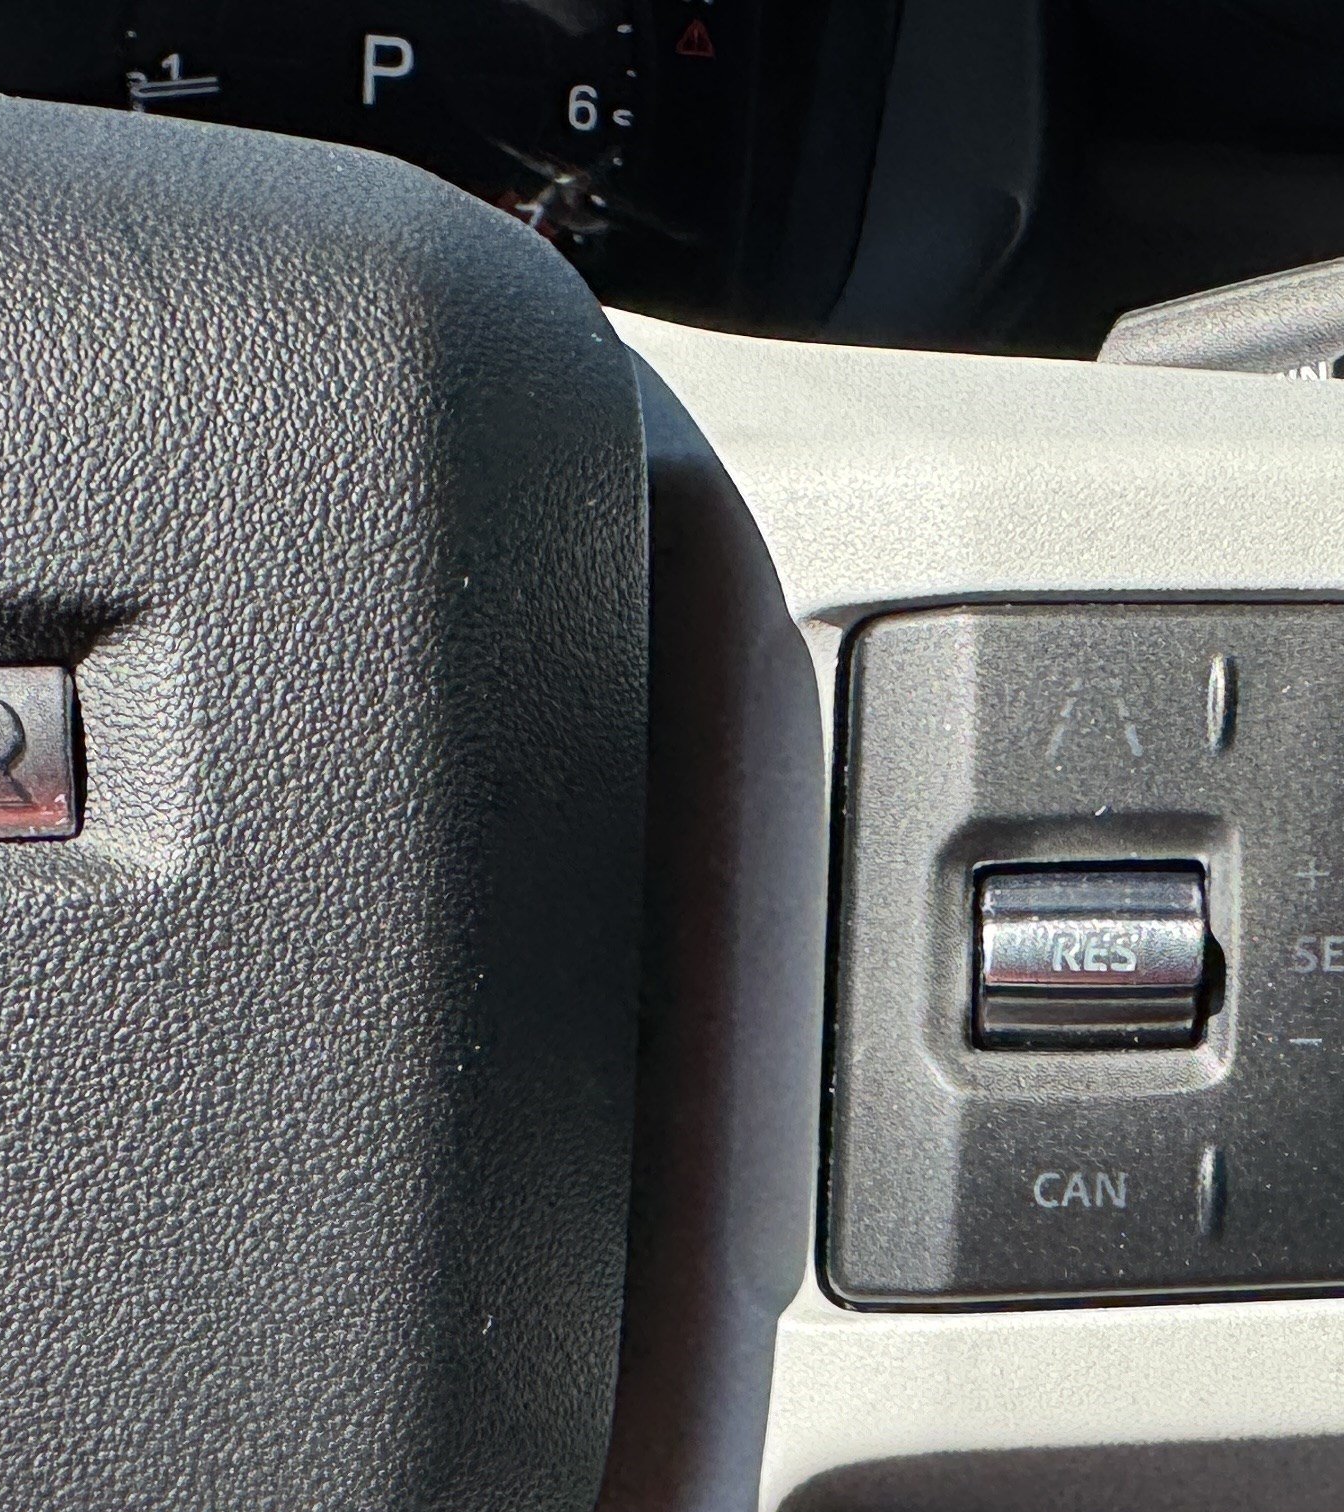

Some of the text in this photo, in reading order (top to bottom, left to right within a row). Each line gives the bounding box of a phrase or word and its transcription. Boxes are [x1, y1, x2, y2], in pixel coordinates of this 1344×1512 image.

[362, 33, 415, 105] P
[567, 83, 599, 132] 6
[1051, 926, 1139, 973] RES
[1033, 1170, 1129, 1209] CAN
